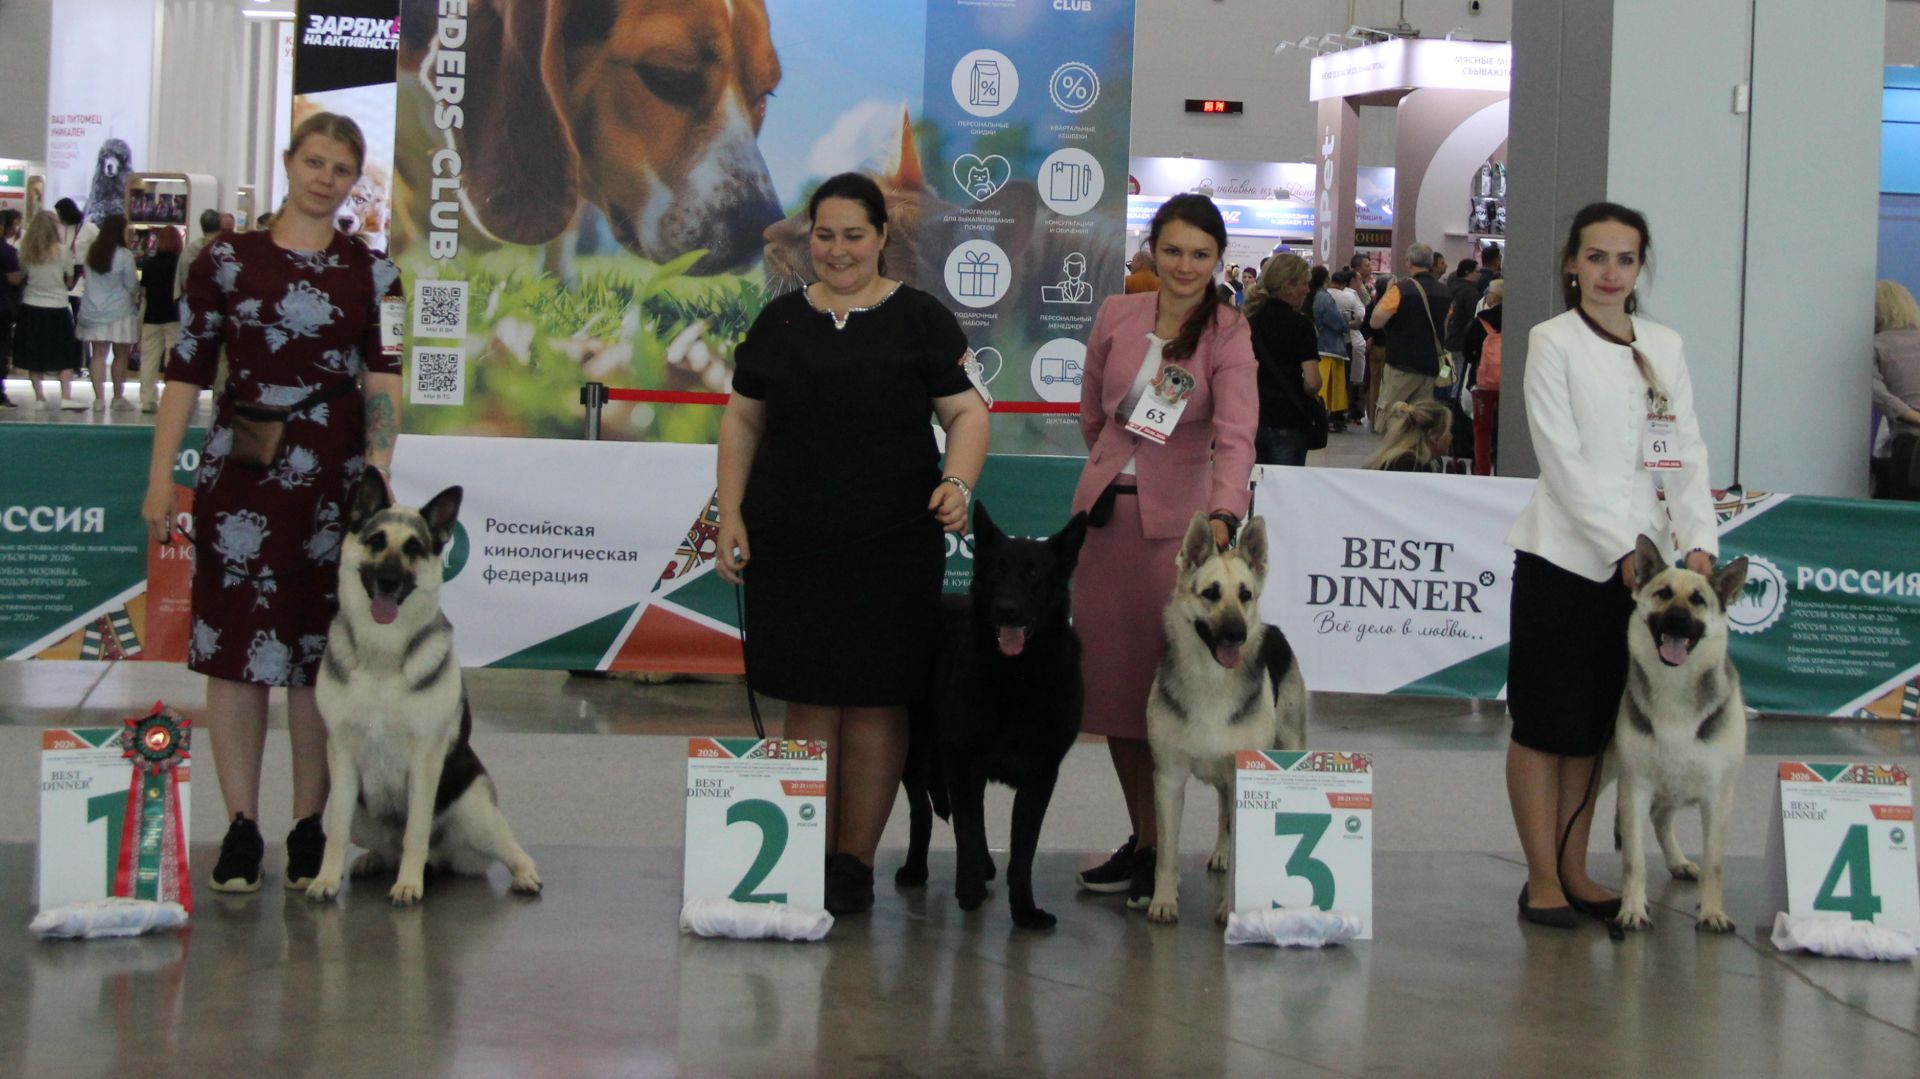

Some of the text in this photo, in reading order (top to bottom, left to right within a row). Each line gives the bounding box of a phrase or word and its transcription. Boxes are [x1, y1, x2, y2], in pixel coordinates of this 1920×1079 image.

[1053, 0, 1092, 11] CLUB
[303, 34, 322, 45] НА
[429, 149, 462, 259] CLUB
[954, 311, 999, 319] ПОДАРОЧНЫЕ
[1146, 408, 1166, 424] 63
[1653, 440, 1667, 453] 61
[0, 505, 105, 533] ССИЯ
[485, 517, 596, 538] Российская
[483, 545, 638, 563] кинологическая
[1340, 536, 1455, 573] BEST
[482, 564, 589, 586] федерация
[1796, 566, 1920, 597] РОССИЯ
[1306, 573, 1483, 613] DINNER
[1402, 618, 1412, 636] в
[697, 749, 719, 757] 2026
[1246, 760, 1266, 769] 2026
[52, 770, 82, 780] BEST
[42, 780, 91, 791] DINNER
[695, 778, 724, 788] BEST
[687, 788, 732, 798] DINNER
[1243, 790, 1272, 800] BEST
[1235, 800, 1278, 810] DINNER
[1790, 800, 1817, 810] BEST
[1782, 809, 1825, 820] DINNER
[87, 789, 132, 898] 1
[726, 798, 789, 904] 2
[1272, 812, 1335, 912] 3
[1813, 823, 1882, 924] 4
